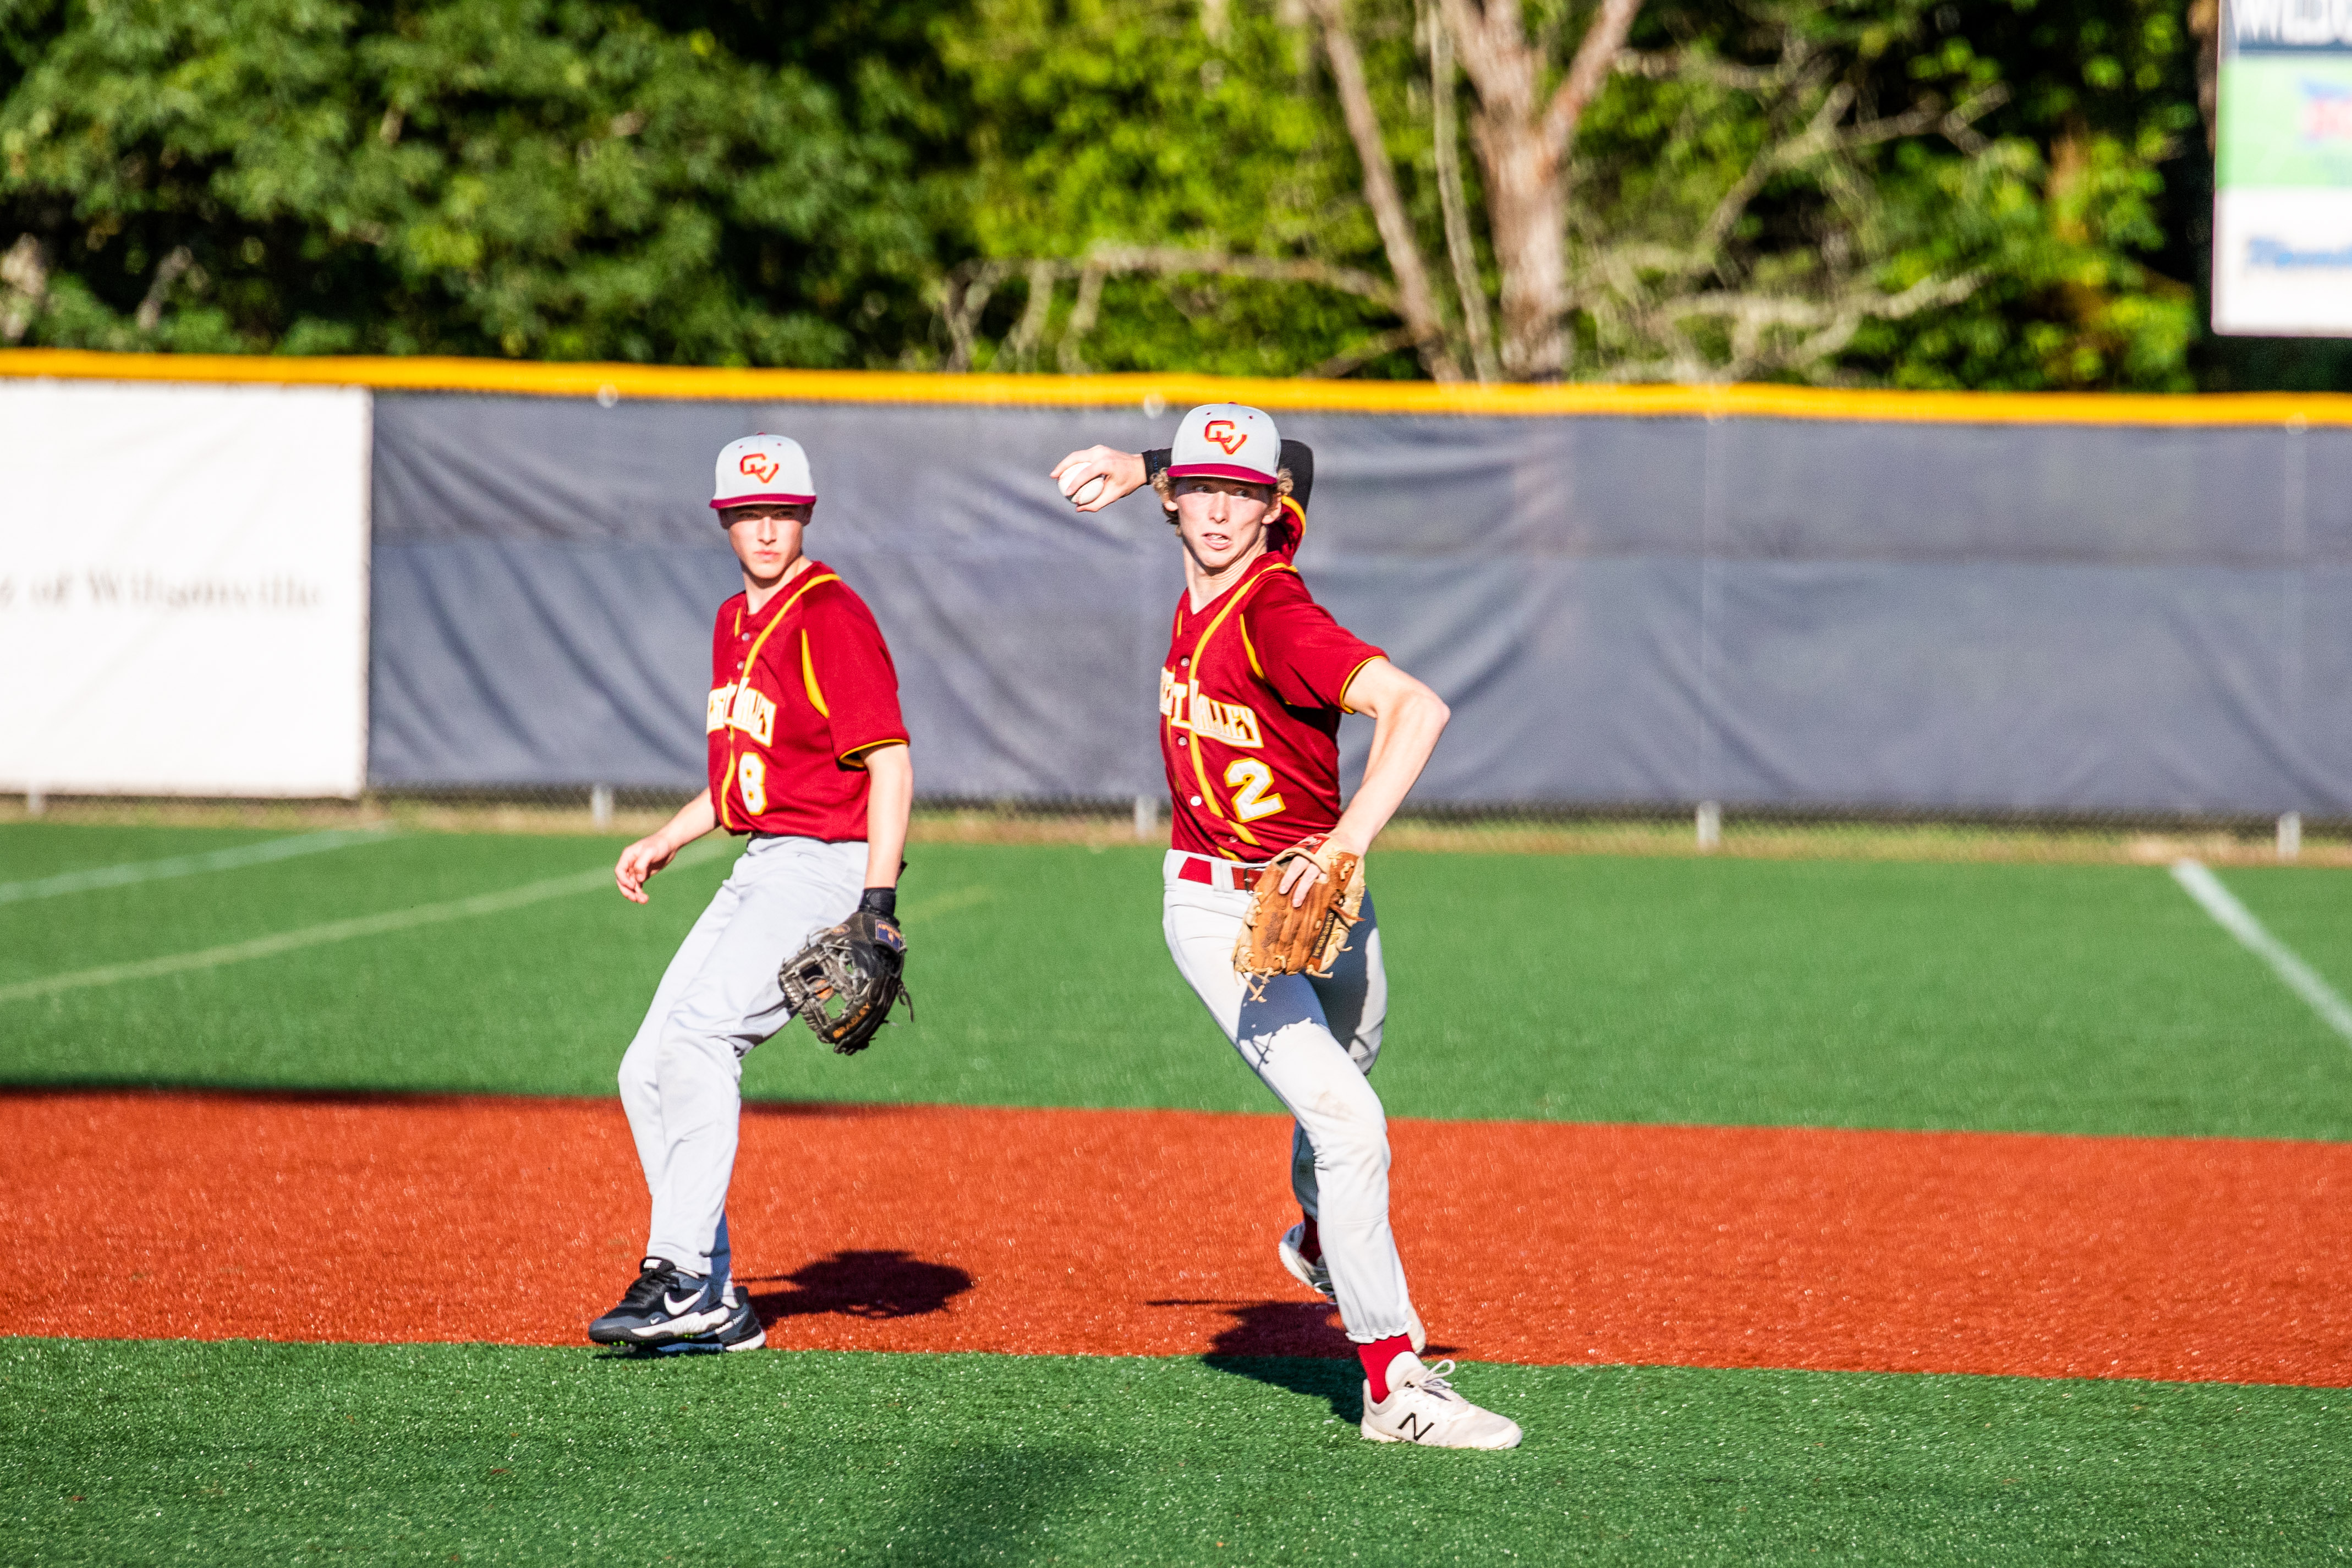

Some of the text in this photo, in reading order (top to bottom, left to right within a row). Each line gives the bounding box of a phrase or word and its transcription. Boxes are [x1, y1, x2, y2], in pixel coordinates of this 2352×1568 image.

[739, 453, 779, 484] CV
[1204, 420, 1248, 455] CV
[1188, 678, 1264, 748] VALLEY
[738, 752, 767, 815] 8
[1222, 757, 1286, 823] 2
